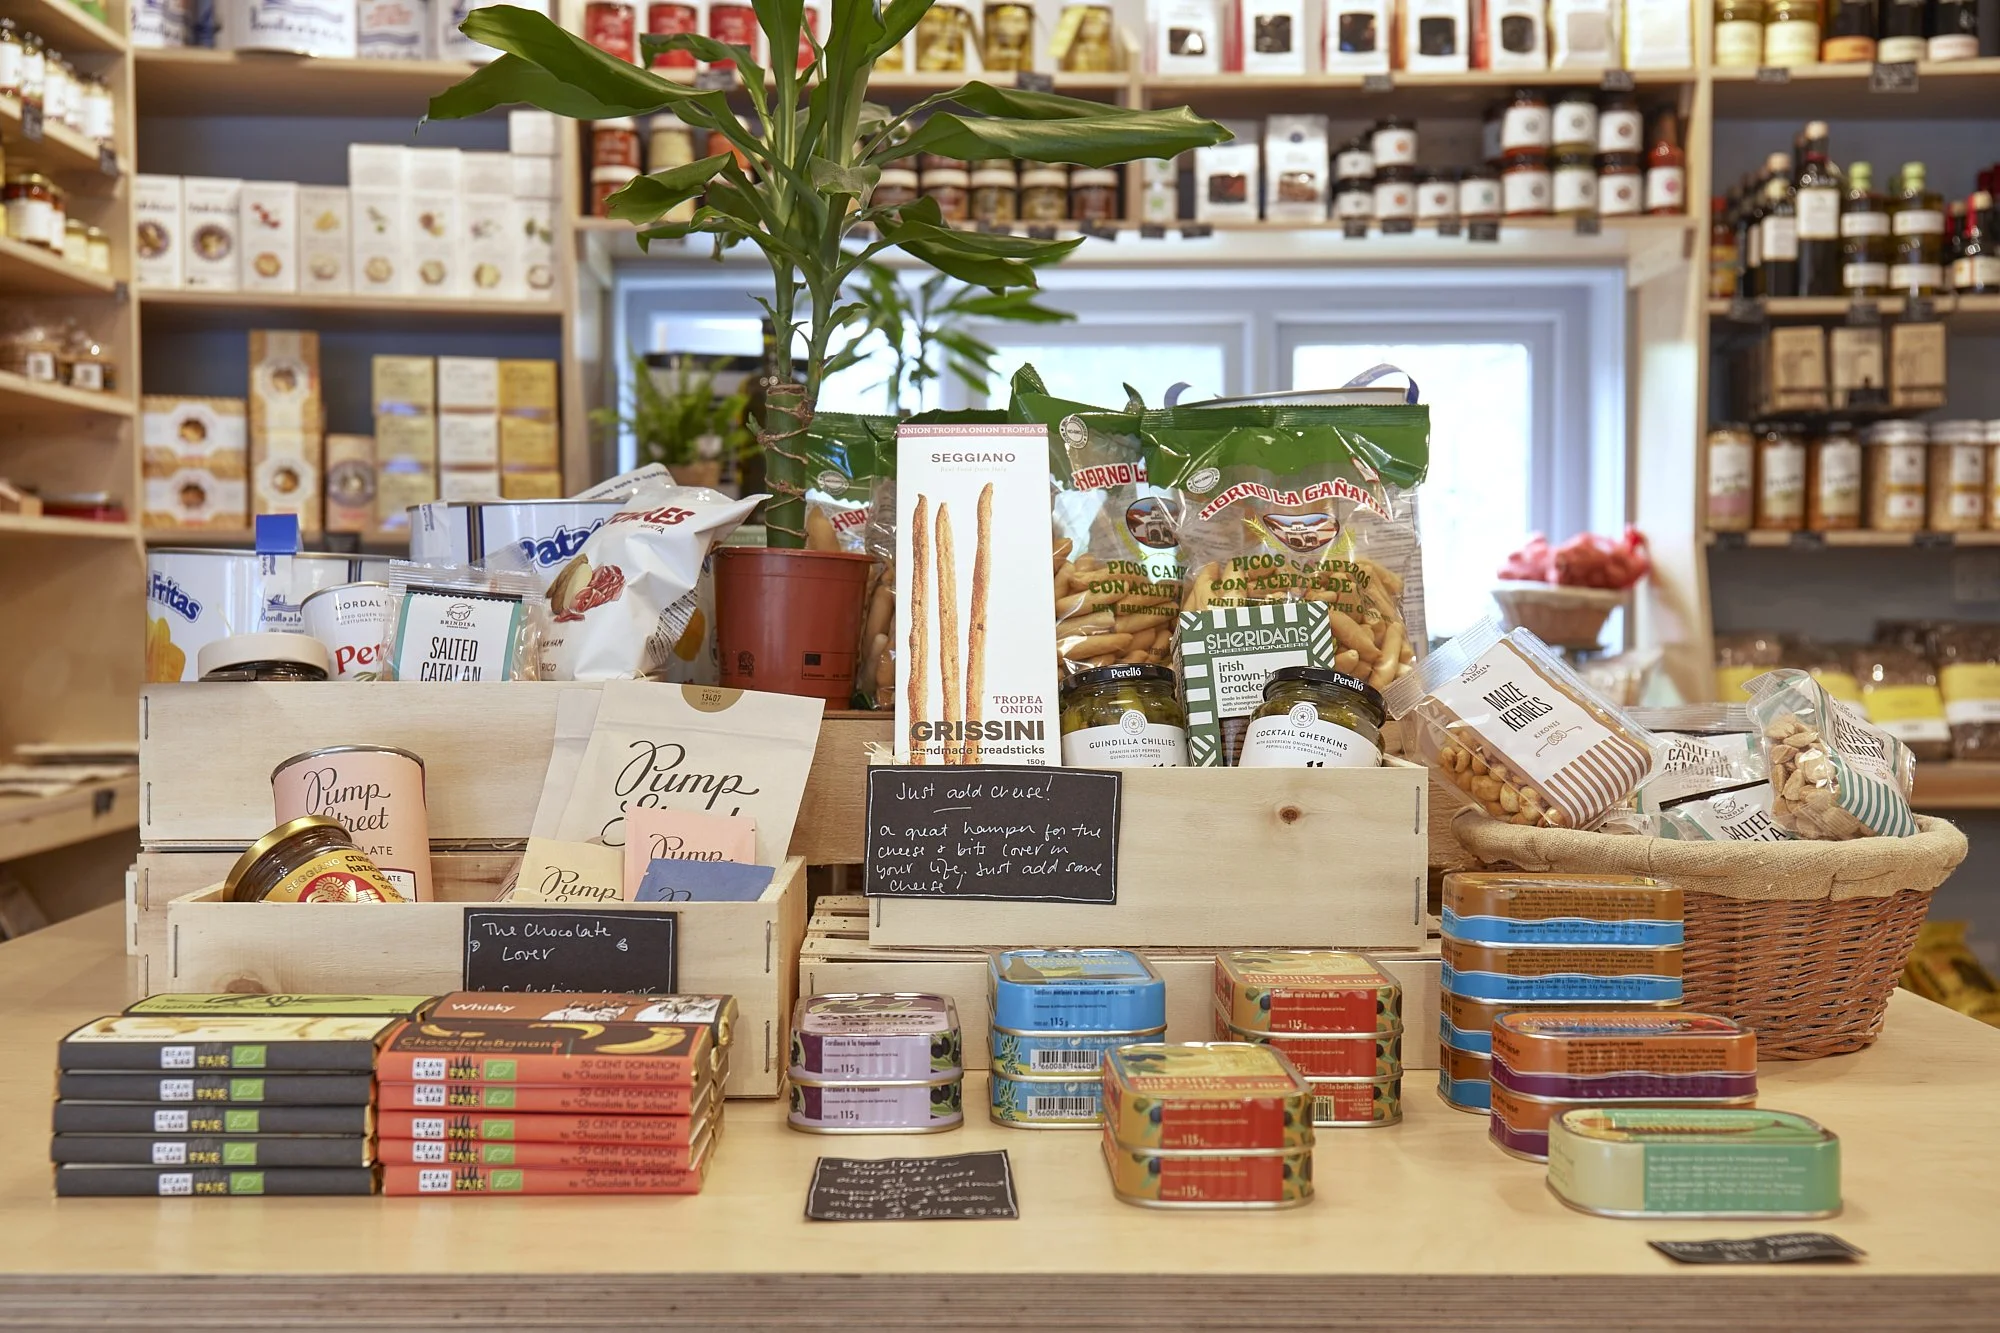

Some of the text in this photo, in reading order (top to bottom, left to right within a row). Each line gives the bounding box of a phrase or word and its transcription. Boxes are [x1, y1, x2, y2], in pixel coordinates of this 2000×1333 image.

[900, 426, 931, 435] ONION
[932, 426, 968, 434] TROPEA
[968, 426, 1000, 434] ONION
[1001, 426, 1036, 434] TROPEA
[931, 453, 1016, 463] SEGGIANO
[1074, 463, 1131, 491] HORNO
[1200, 482, 1270, 521] HORNO
[1272, 489, 1303, 507] LA
[832, 509, 869, 534] HOR
[1107, 561, 1188, 580] PICOS CAMP
[1232, 554, 1286, 572] PICOS
[1088, 580, 1176, 597] CON ACEITE
[1210, 573, 1353, 593] CON ACEITE DE
[151, 573, 200, 621] Fritas
[440, 619, 476, 628] BRINDISA
[429, 636, 479, 663] SALTED
[420, 661, 481, 681] CATALAN
[1218, 660, 1244, 673] irish
[1462, 664, 1492, 685] BRINDISA
[992, 695, 1043, 704] TROPEA
[1482, 681, 1528, 712] MAIZE
[1000, 705, 1043, 714] ONION
[1499, 696, 1553, 732] KERNELS
[911, 720, 1045, 741] GRISSINI
[1836, 714, 1873, 737] ALTED
[912, 745, 1045, 755] handmade breadsticks
[1089, 738, 1176, 749] GUINDILLA CHILLIES
[1256, 729, 1348, 751] COCKTAIL GHERKINS
[1835, 737, 1887, 761] ALMON
[614, 739, 760, 811] Pump
[303, 767, 391, 815] Pump
[896, 782, 935, 800] Just
[946, 783, 982, 799] add
[880, 822, 1101, 843] a great hamper for the
[649, 833, 734, 862] Pump
[877, 844, 925, 858] cheese
[957, 837, 986, 857] bits
[1002, 843, 1045, 857] lover
[285, 858, 340, 893] SEGGIANO
[876, 863, 913, 879] your
[975, 862, 1012, 876] Just
[1022, 860, 1058, 875] add
[1065, 861, 1102, 876] some
[539, 865, 624, 901] Pump
[482, 920, 611, 938] The Chocolate
[501, 946, 556, 962] Lover
[451, 1003, 516, 1013] Whisky
[1050, 1018, 1064, 1027] 115
[1288, 1020, 1302, 1030] 115
[841, 1064, 855, 1073] 115
[840, 1111, 854, 1119] 115
